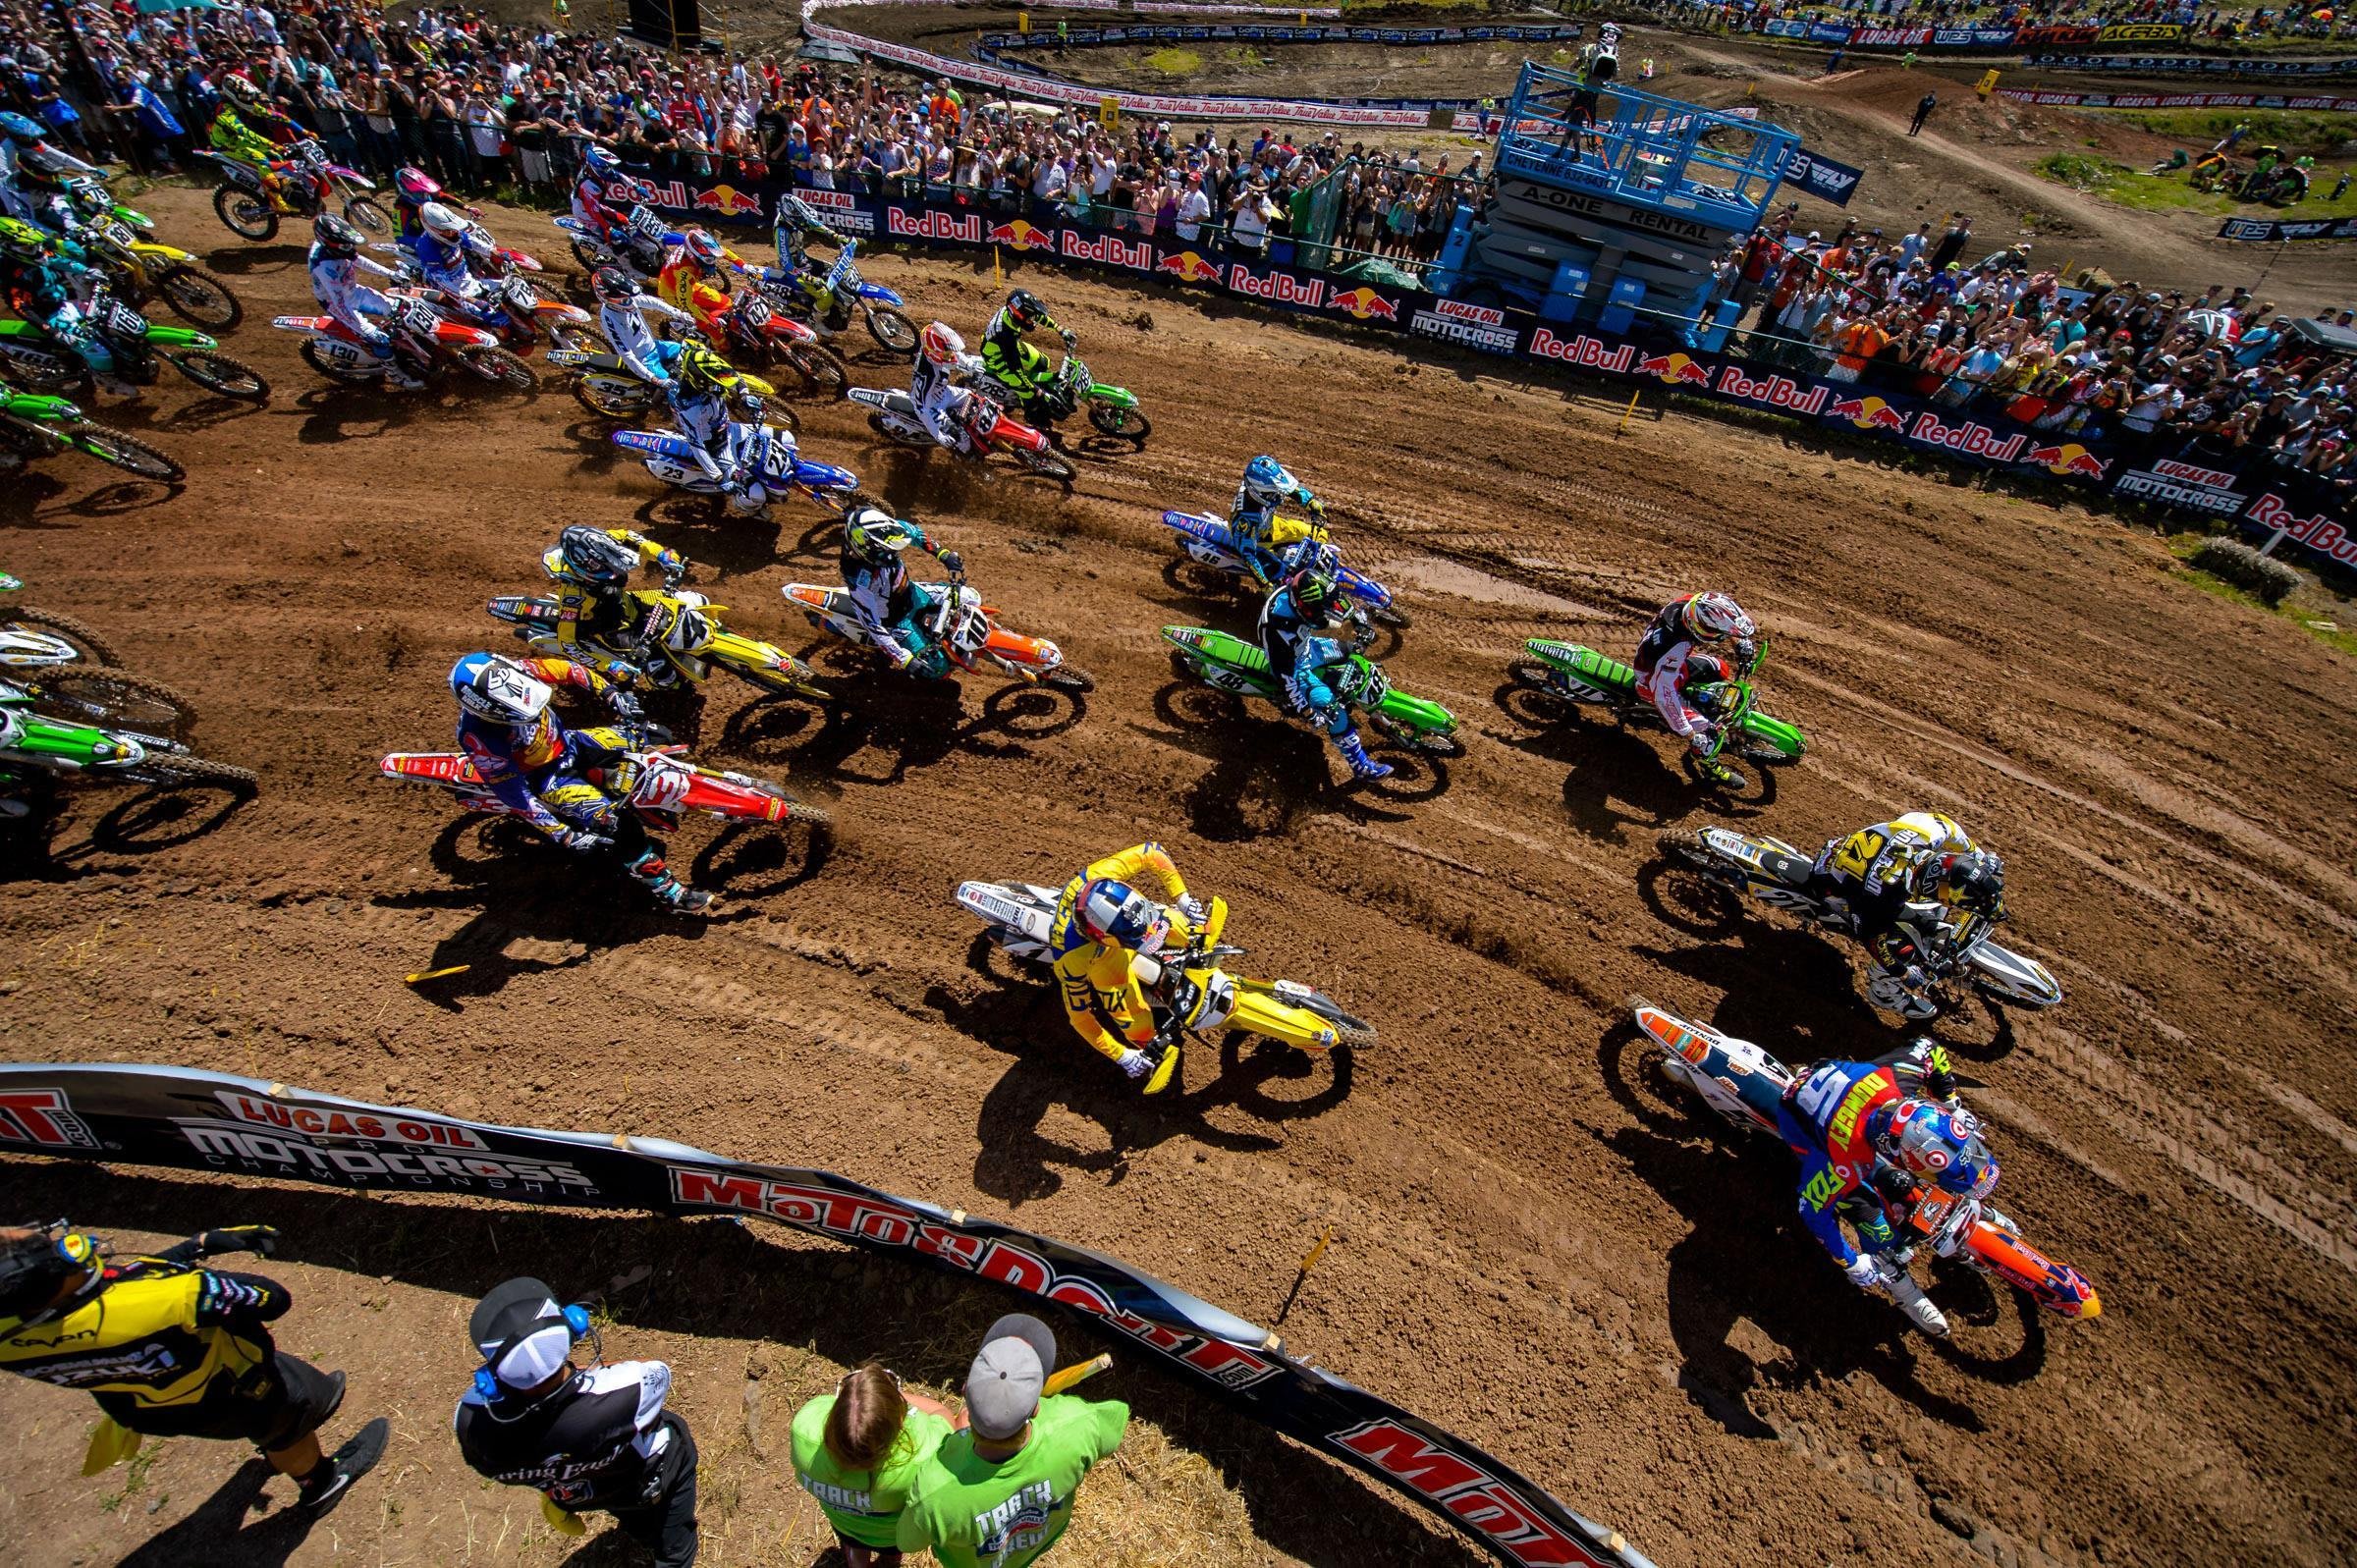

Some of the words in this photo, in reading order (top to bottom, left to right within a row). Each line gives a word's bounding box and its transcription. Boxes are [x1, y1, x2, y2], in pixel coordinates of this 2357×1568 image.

[1856, 29, 1902, 44] LUCAS
[1903, 29, 1927, 44] OIL
[2103, 26, 2180, 41] ACERBIS
[834, 194, 853, 209] OIL
[1522, 187, 1604, 214] A-ONE
[1628, 210, 1710, 242] RENTAL
[1453, 234, 1464, 247] 2
[411, 301, 438, 333] 130
[749, 298, 770, 326] 42
[1438, 300, 1481, 321] LUCAS
[1480, 309, 1504, 326] OIL
[1412, 315, 1517, 351] MOTOCROSS
[329, 344, 359, 363] 130
[662, 465, 685, 480] 23
[768, 441, 789, 475] 23
[2158, 460, 2208, 483] LUCAS
[2207, 472, 2233, 490] OIL
[2115, 473, 2244, 514] MOTOCROSS
[1198, 551, 1220, 566] 46
[1834, 830, 1885, 881] 21
[1050, 872, 1084, 952] ROCZEN
[1679, 1022, 1722, 1047] DUNLOP
[1796, 1062, 1852, 1127] 5
[241, 1097, 388, 1139] LUCAS
[396, 1120, 482, 1150] OIL
[1828, 1073, 1891, 1153] DUNGEY
[181, 1127, 595, 1187] MOTOCROSS
[304, 1137, 426, 1155] PRO
[207, 1155, 601, 1196] CHAMPIONSHIP
[1804, 1162, 1848, 1214] FOX
[801, 1473, 872, 1508] TRACK
[974, 1479, 1053, 1537] TRACK
